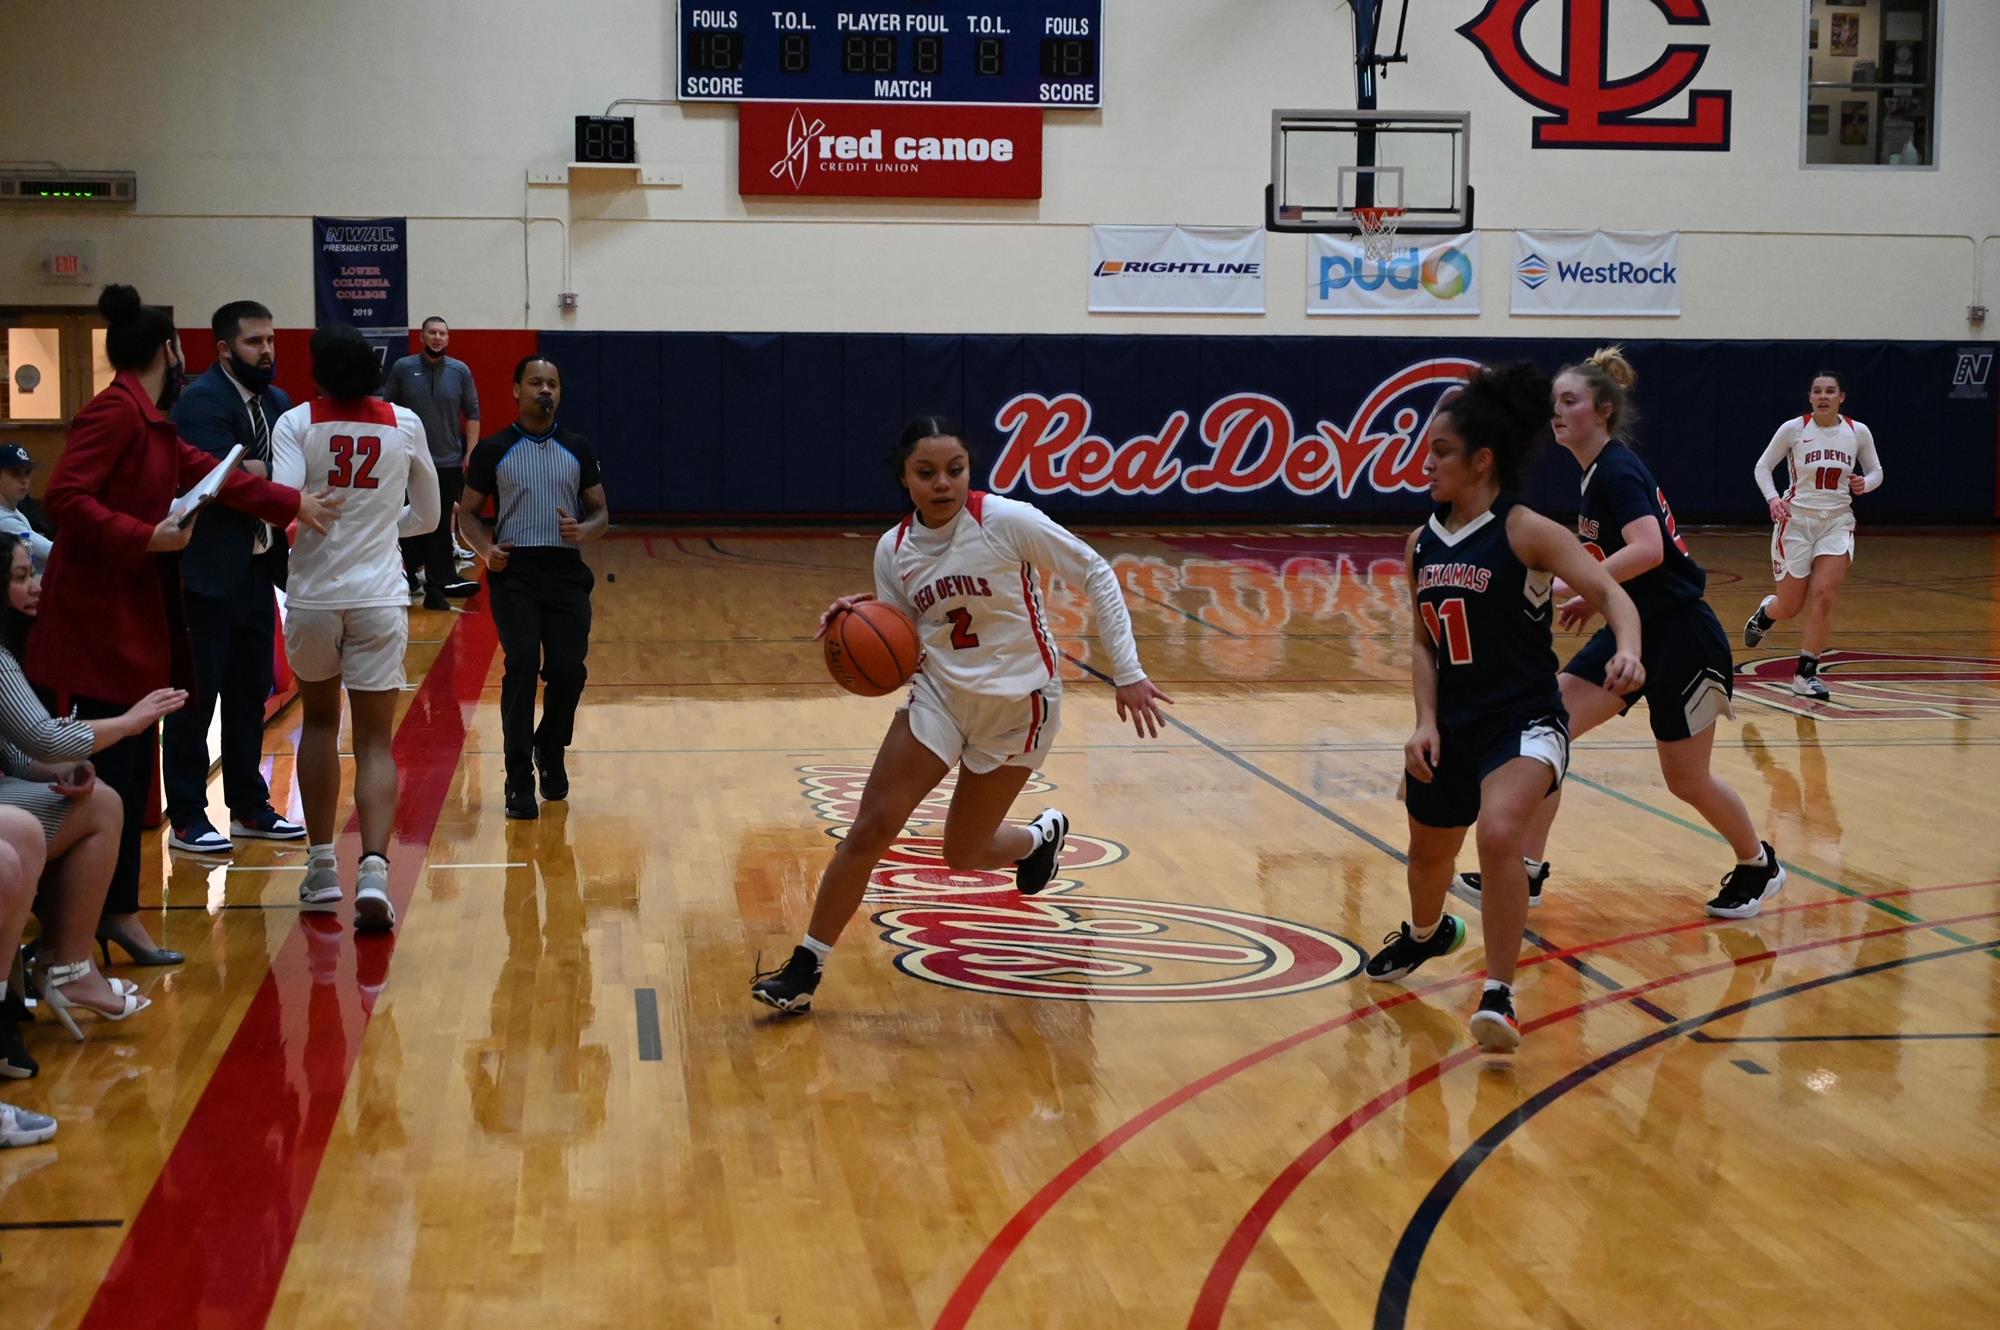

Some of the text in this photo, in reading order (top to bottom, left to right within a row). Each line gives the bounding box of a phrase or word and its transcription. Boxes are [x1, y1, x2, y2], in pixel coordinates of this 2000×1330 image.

[693, 10, 738, 28] FOULS
[772, 12, 816, 29] T.O.L.
[837, 13, 949, 32] PLAYER FOUL
[967, 16, 1011, 33] T.O.L.
[1045, 17, 1089, 35] FOULS
[687, 77, 744, 95] SCORE
[874, 80, 932, 98] MATCH
[1039, 84, 1094, 101] SCORE
[819, 129, 1014, 162] red canoe
[820, 162, 919, 173] CREDIT UNION
[323, 244, 399, 252] PRESIDENTS CUP
[56, 255, 78, 273] EXIT
[341, 266, 381, 275] LOWER
[1123, 262, 1260, 274] RIGHTLINE
[1557, 261, 1677, 284] WestRock
[1320, 247, 1419, 300] pud
[332, 279, 390, 288] COLUMBIA
[336, 291, 387, 299] COLLEGE
[352, 308, 373, 317] 2019
[989, 357, 1492, 499] Red Devil
[328, 434, 381, 489] 32
[1805, 449, 1821, 465] RED
[1815, 467, 1842, 490] 10
[935, 575, 992, 601] DEVILS
[946, 607, 979, 650] 2
